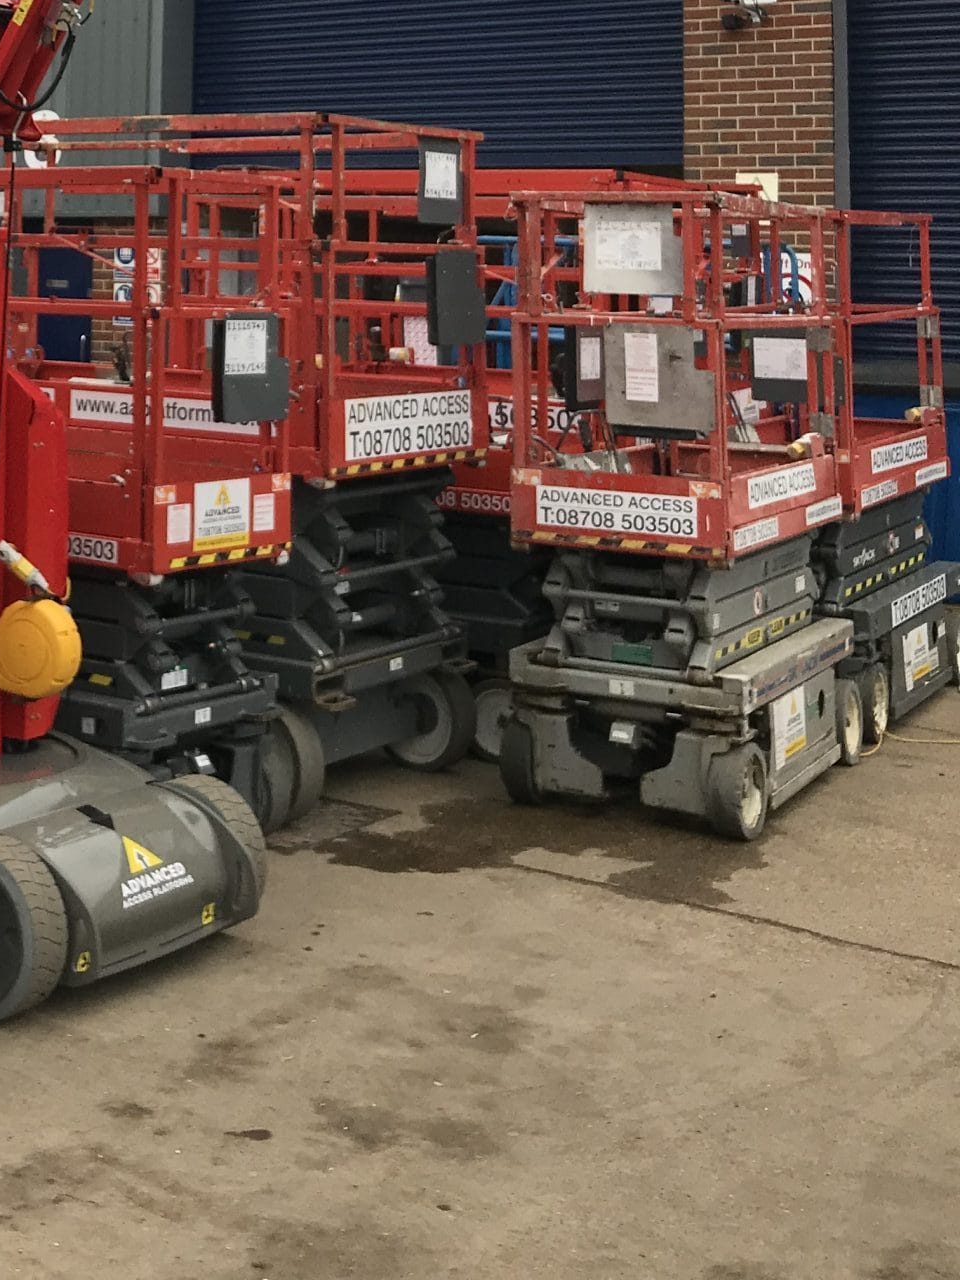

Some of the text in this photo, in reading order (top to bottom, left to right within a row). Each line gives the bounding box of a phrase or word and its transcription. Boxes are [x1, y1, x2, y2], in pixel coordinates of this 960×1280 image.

[348, 393, 469, 424] ADVANCED ACCESS
[350, 421, 470, 457] T:08708 503503
[873, 438, 927, 468] ADVANCED ACCESS
[751, 468, 815, 502] ADVANCED ACCESS
[540, 489, 693, 513] ADVANCED ACCESS
[540, 506, 694, 536] T:08708 503503
[121, 861, 187, 898] ADVANCED
[122, 890, 154, 909] ACCESS
